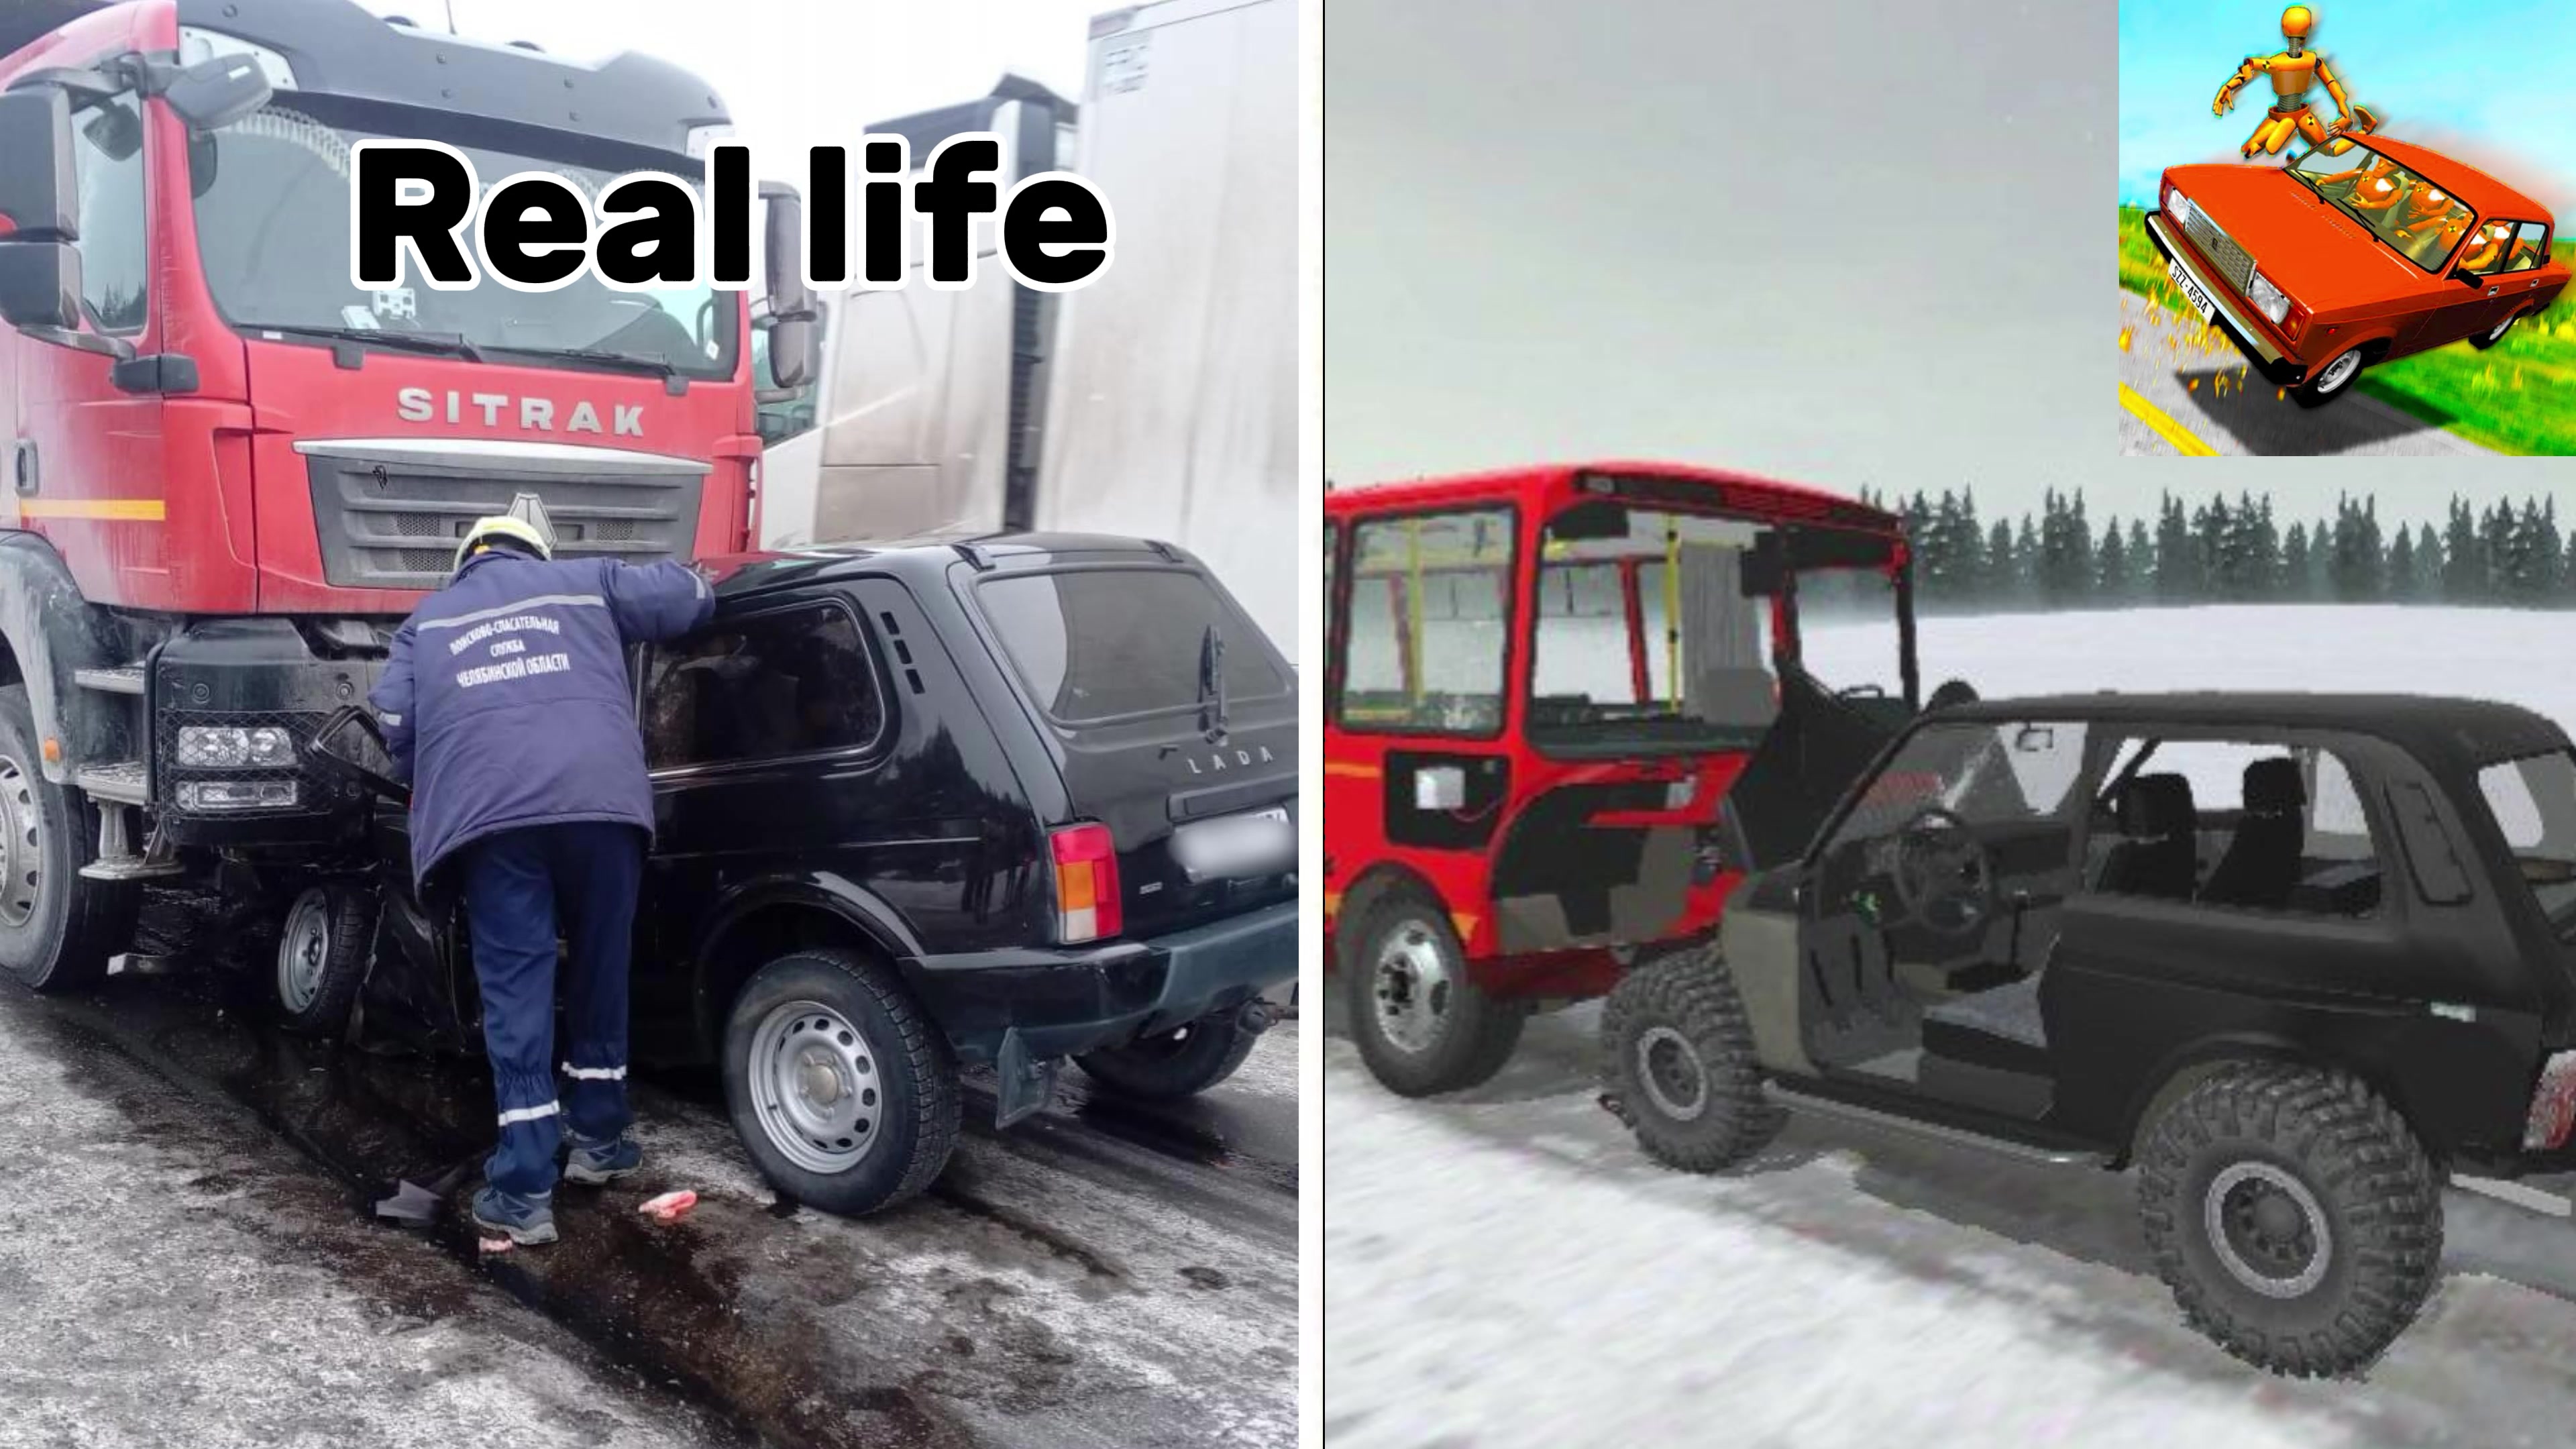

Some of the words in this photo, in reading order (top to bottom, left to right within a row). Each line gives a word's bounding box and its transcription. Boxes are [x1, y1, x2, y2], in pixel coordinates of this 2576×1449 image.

[2171, 264, 2208, 314] SZZ-4594
[397, 387, 644, 436] SITRAK
[449, 616, 560, 655] ПОИСКОВО-СПАСАТЕЛЬНАЯ
[490, 639, 526, 657] СЛУЖБА
[456, 657, 527, 688] ЧЕЛЯБИНСКОЙ
[526, 653, 571, 675] ОБЛАСТИ
[1187, 745, 1273, 773] LADA
